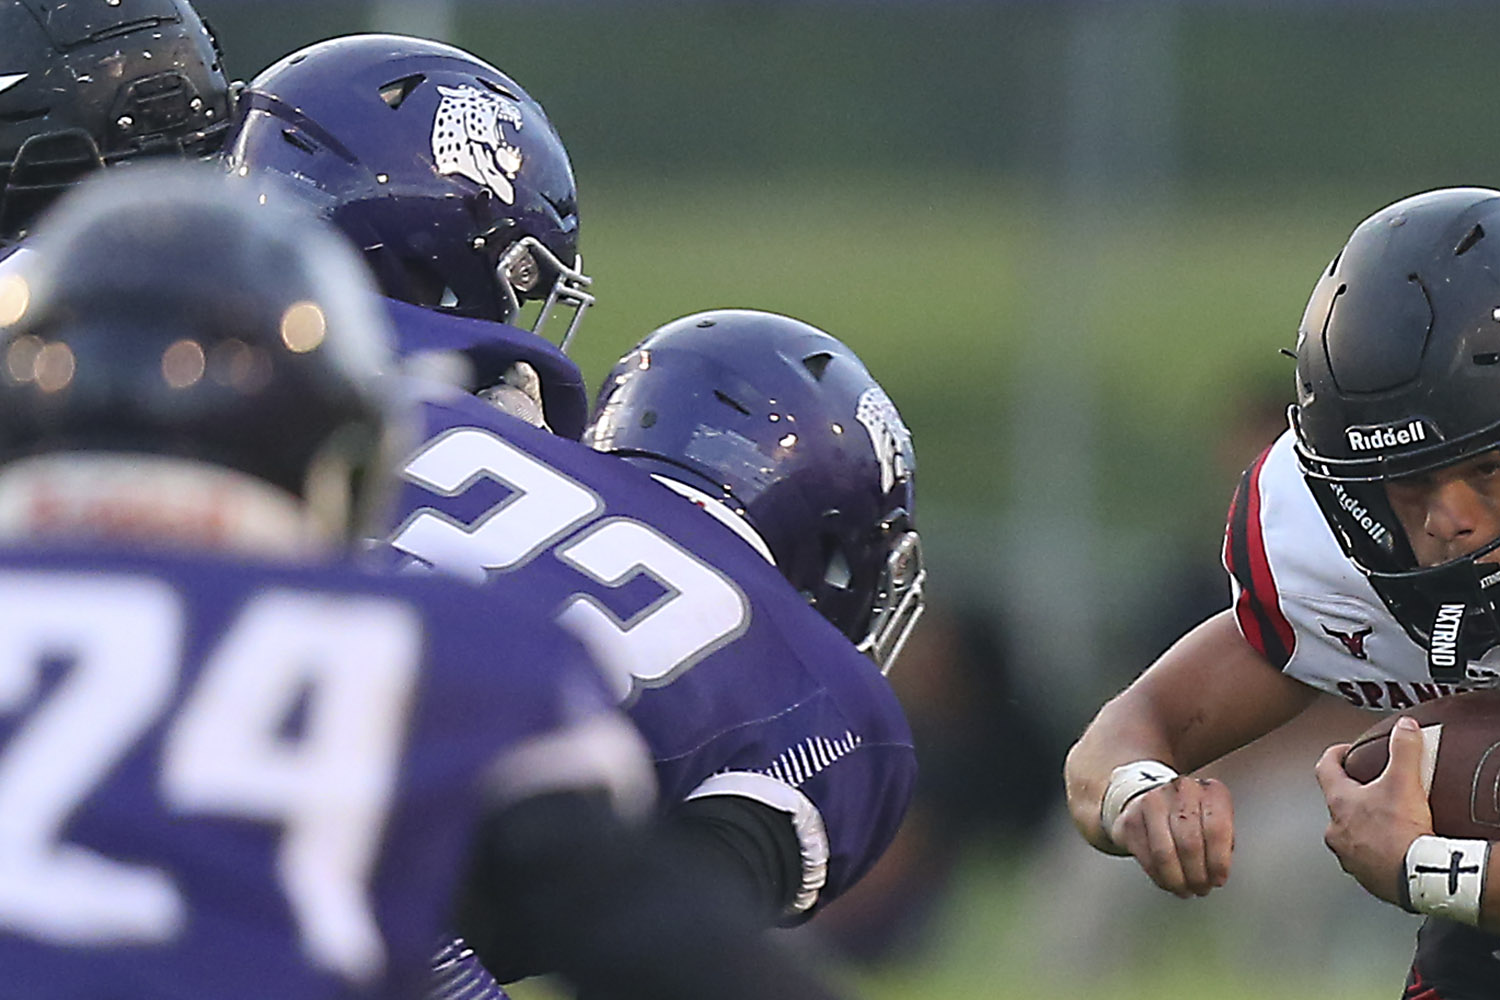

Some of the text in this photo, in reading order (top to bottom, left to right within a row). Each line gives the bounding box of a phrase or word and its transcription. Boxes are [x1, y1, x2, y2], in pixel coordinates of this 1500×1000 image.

[1347, 420, 1426, 451] Riddell
[1430, 603, 1466, 668] NXTRND
[0, 566, 425, 988] 24
